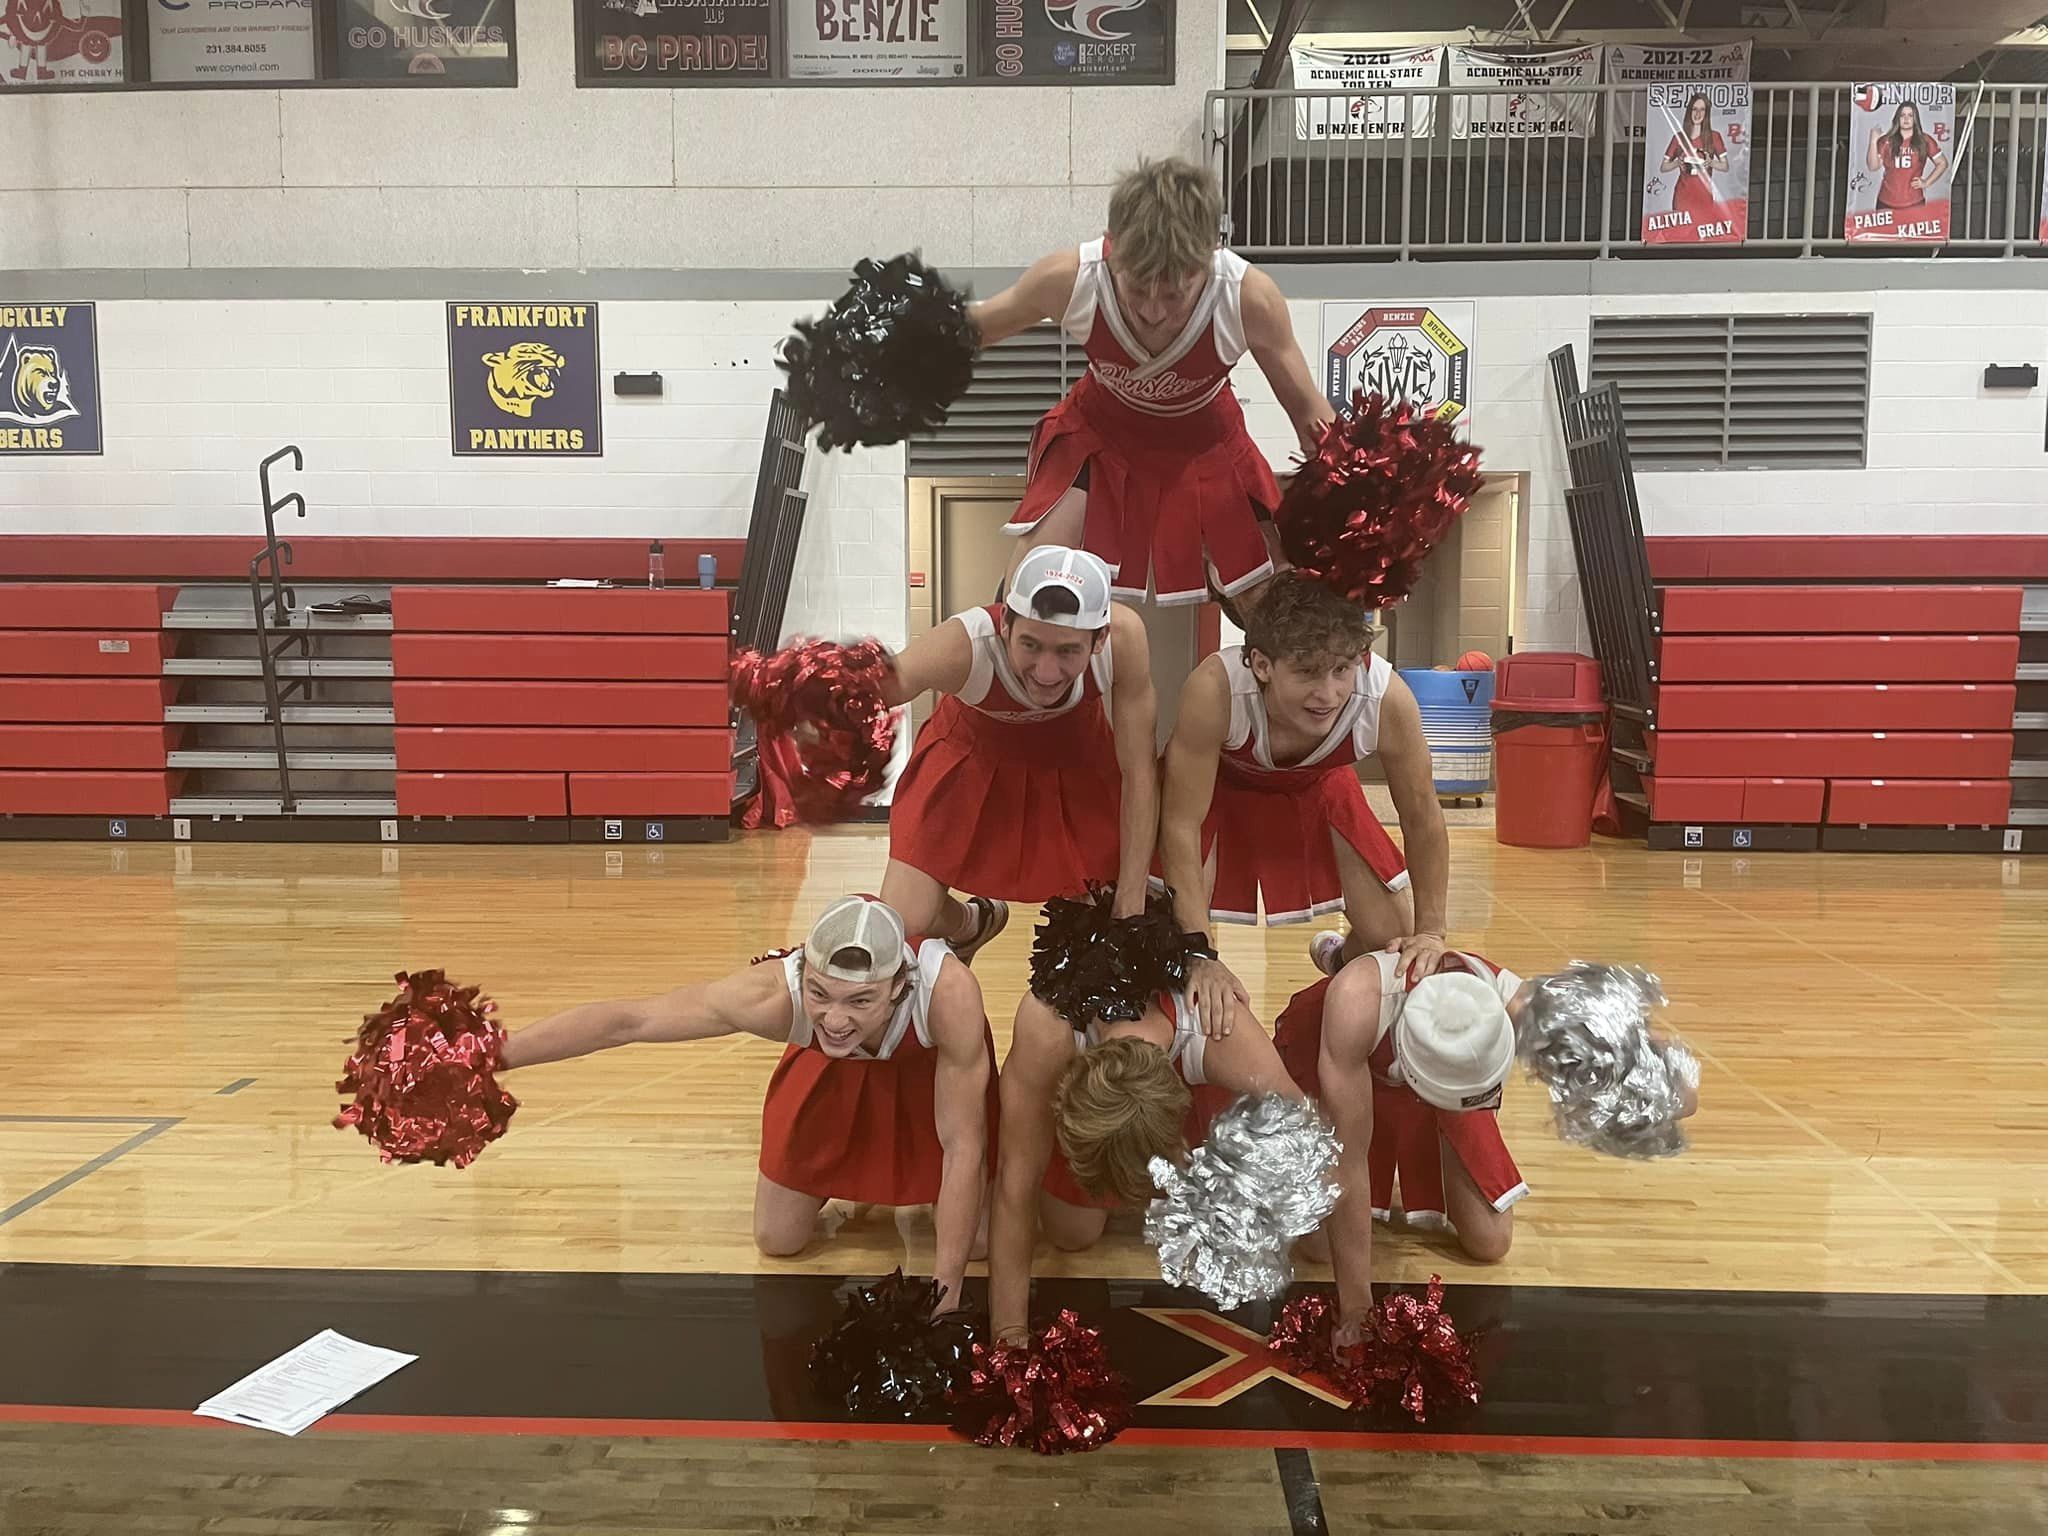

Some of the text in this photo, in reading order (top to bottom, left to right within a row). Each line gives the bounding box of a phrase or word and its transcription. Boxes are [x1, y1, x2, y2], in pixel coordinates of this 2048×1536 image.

[815, 0, 939, 43] BENZIE
[348, 25, 504, 49] GO HUSKIES
[601, 34, 768, 71] BC PRIDE!
[1087, 43, 1136, 57] ZICKERT
[1643, 50, 1713, 65] 2021-22
[195, 62, 279, 73] www.coyneoil.com
[995, 43, 1023, 77] GO
[1343, 54, 1390, 65] 2020
[60, 69, 75, 78] THE
[78, 69, 111, 78] CHERRY
[1310, 68, 1423, 79] ACADEMIC ALL-STATE
[1466, 66, 1583, 77] ACADEMIC ALL-STATE
[1621, 67, 1733, 80] ACADEMIC ALL-STATE
[1648, 210, 1692, 231] ALIVIA
[1697, 220, 1733, 238] GRAY
[1854, 211, 1894, 229] PAIGE
[1897, 220, 1941, 238] KAPLE
[0, 306, 67, 327] CKLEY
[455, 306, 587, 327] FRANKFORT
[1383, 312, 1415, 321] BENZIE
[1427, 320, 1457, 350] BUCKLEY
[469, 429, 584, 450] PANTHERS
